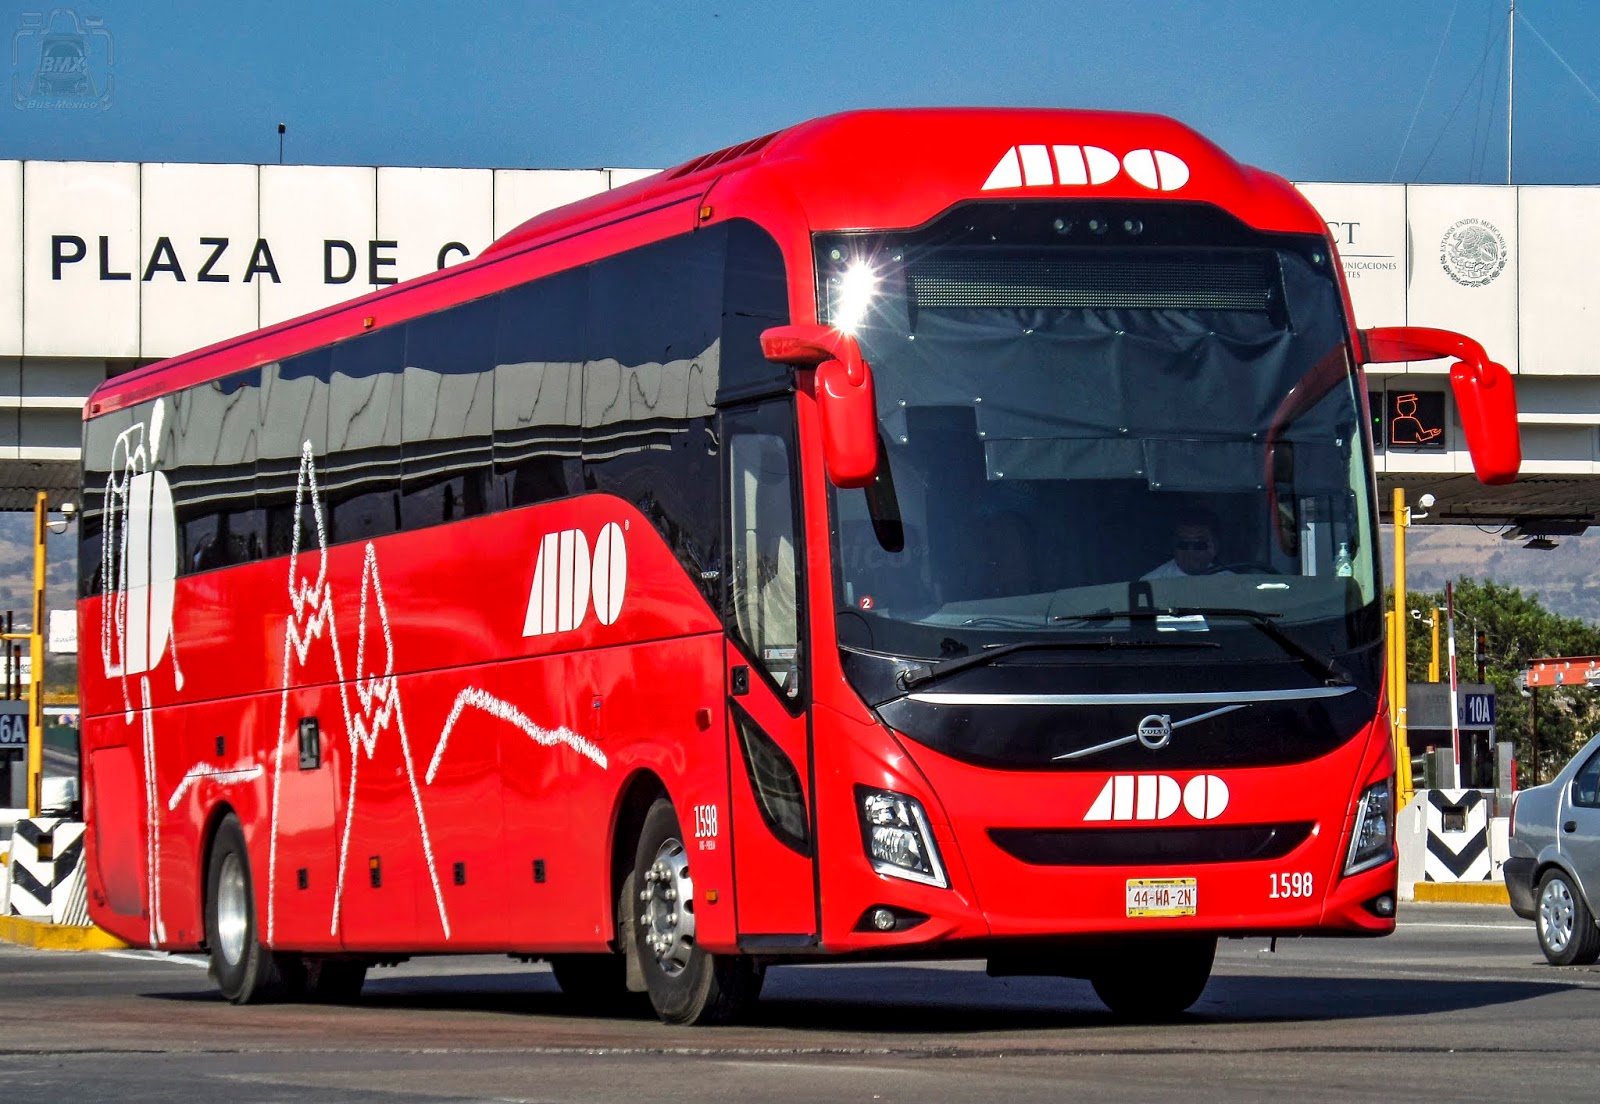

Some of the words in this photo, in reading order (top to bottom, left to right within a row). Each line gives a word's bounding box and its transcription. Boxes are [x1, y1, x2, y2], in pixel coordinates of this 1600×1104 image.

[981, 144, 1190, 192] ADO
[1455, 218, 1479, 228] UNIDOS
[51, 235, 281, 284] PLAZA
[323, 239, 399, 285] DE
[522, 521, 628, 638] ADO
[862, 597, 871, 609] 2
[1469, 696, 1491, 723] 10A
[0, 714, 26, 743] 6A
[1083, 774, 1230, 821] ADO
[693, 804, 718, 838] 1598
[1133, 889, 1192, 906] 44-HA-2N
[1268, 871, 1314, 899] 1598
